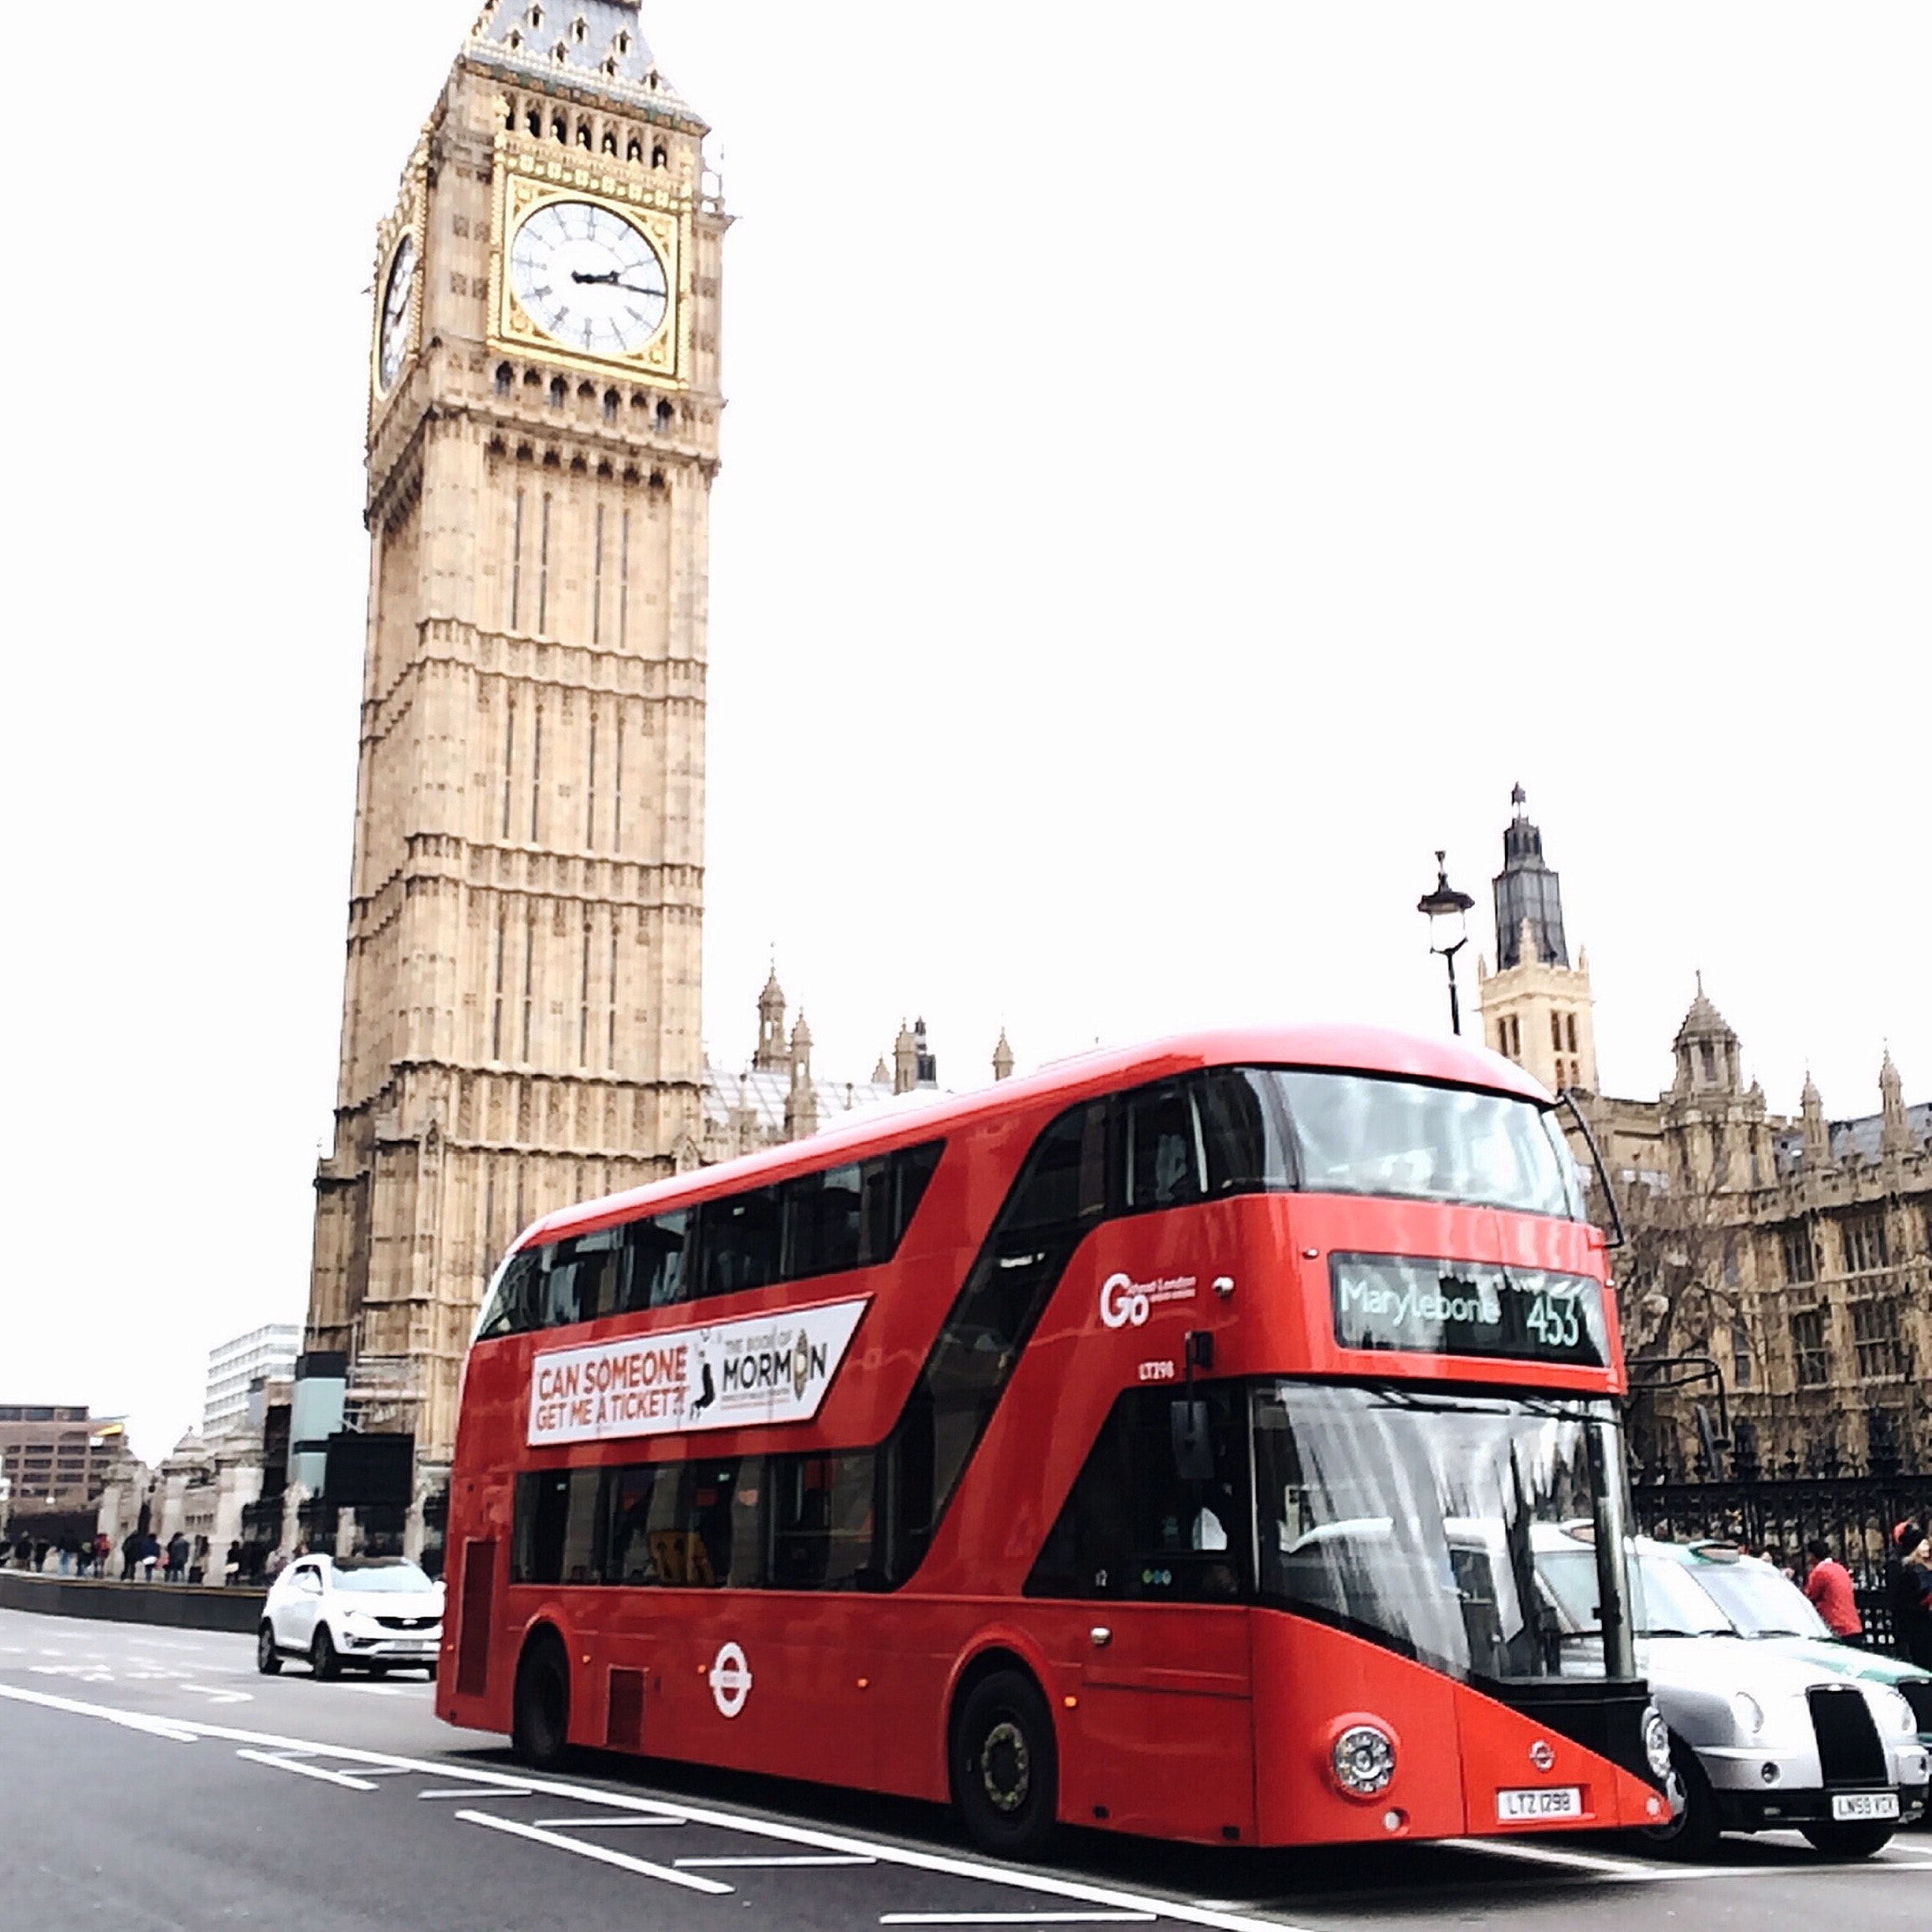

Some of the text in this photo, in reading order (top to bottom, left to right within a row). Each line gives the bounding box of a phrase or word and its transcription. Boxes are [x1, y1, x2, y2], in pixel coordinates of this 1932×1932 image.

[1100, 1272, 1149, 1328] Go
[1341, 1276, 1580, 1347] Marylebone 453
[539, 1343, 689, 1401] CAN SOMEONE
[722, 1329, 828, 1400] MORMON
[536, 1401, 567, 1431] GET
[570, 1397, 593, 1426] ME
[597, 1395, 608, 1424] A
[1507, 1793, 1537, 1816] LTZ
